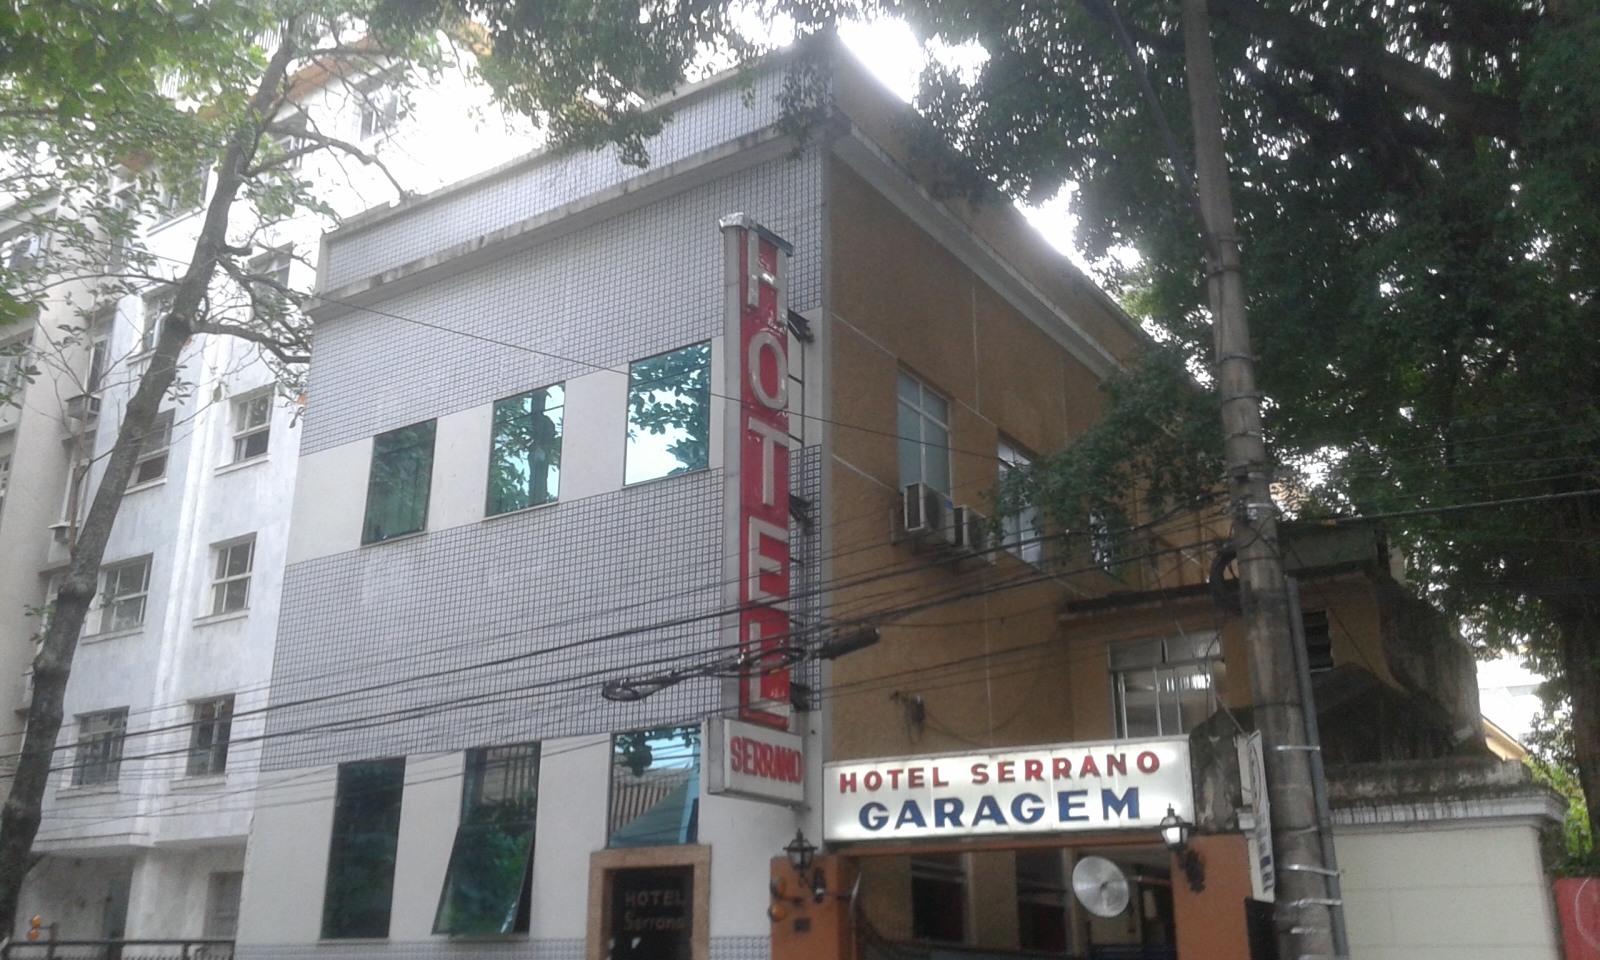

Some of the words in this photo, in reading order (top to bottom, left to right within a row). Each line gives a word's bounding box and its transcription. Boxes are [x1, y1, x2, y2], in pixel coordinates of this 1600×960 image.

[747, 226, 790, 718] HOTEL
[731, 736, 803, 784] SERRANO
[840, 766, 950, 793] HOTEL
[970, 751, 1161, 785] SERRANO
[858, 786, 1141, 832] GARAGEM
[624, 889, 684, 908] HOTEL
